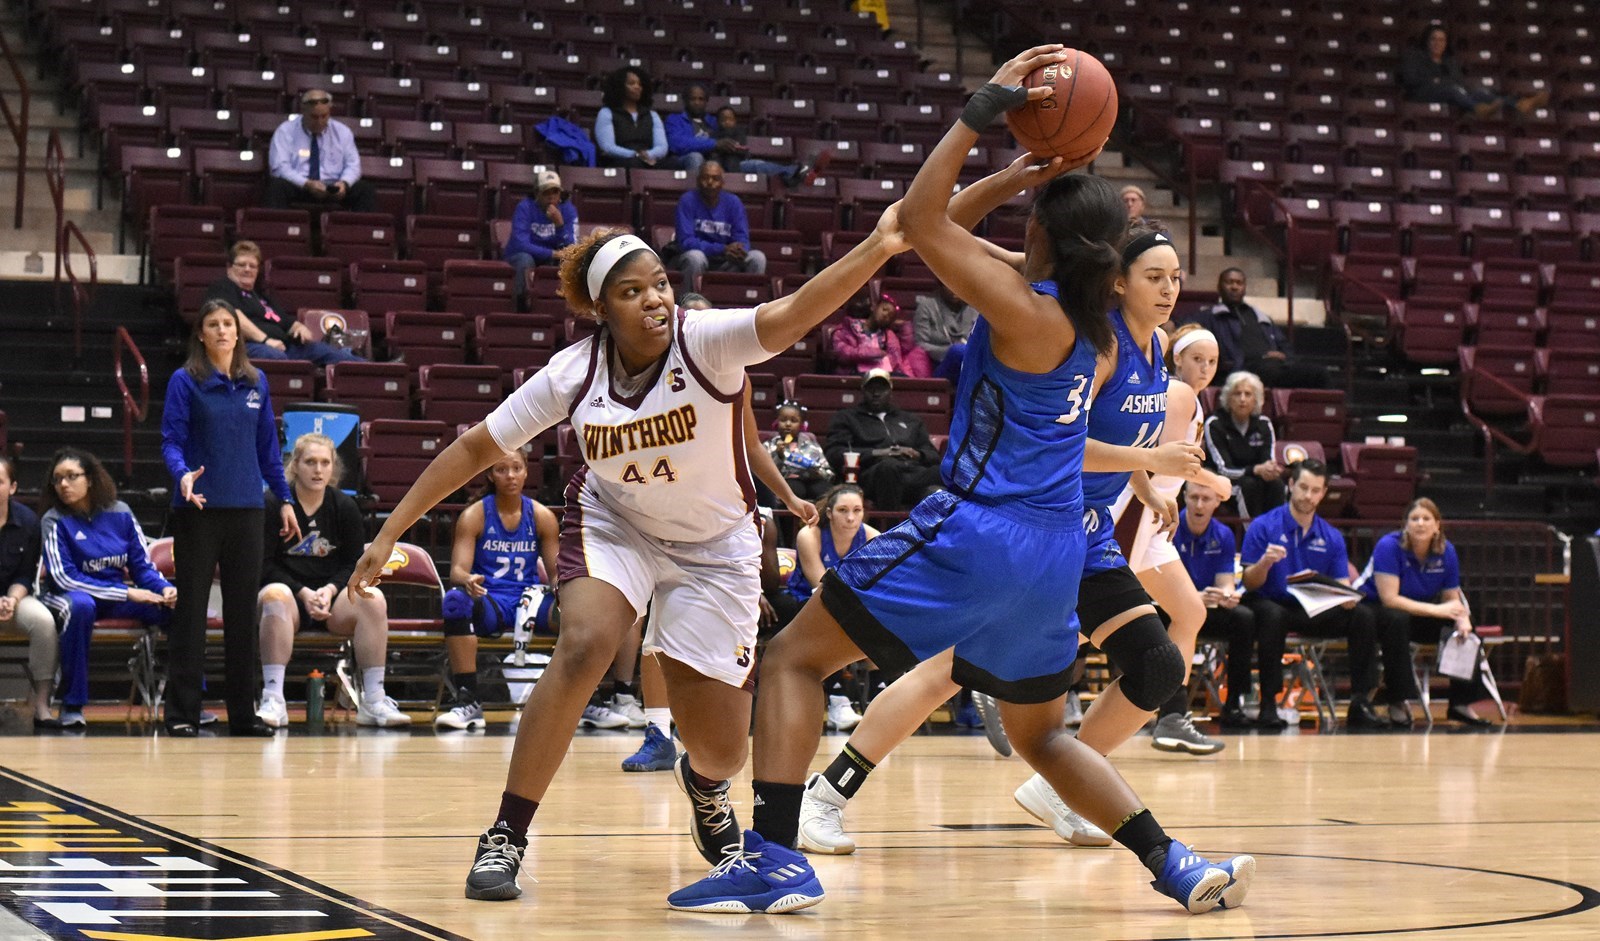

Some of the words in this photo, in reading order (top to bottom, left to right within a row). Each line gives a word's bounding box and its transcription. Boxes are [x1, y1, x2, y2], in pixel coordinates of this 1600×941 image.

[583, 402, 697, 461] WINTHROP
[619, 455, 679, 486] 44
[483, 539, 537, 553] ASHEVILLE
[82, 553, 128, 573] ASHEVILL
[493, 556, 526, 582] 23
